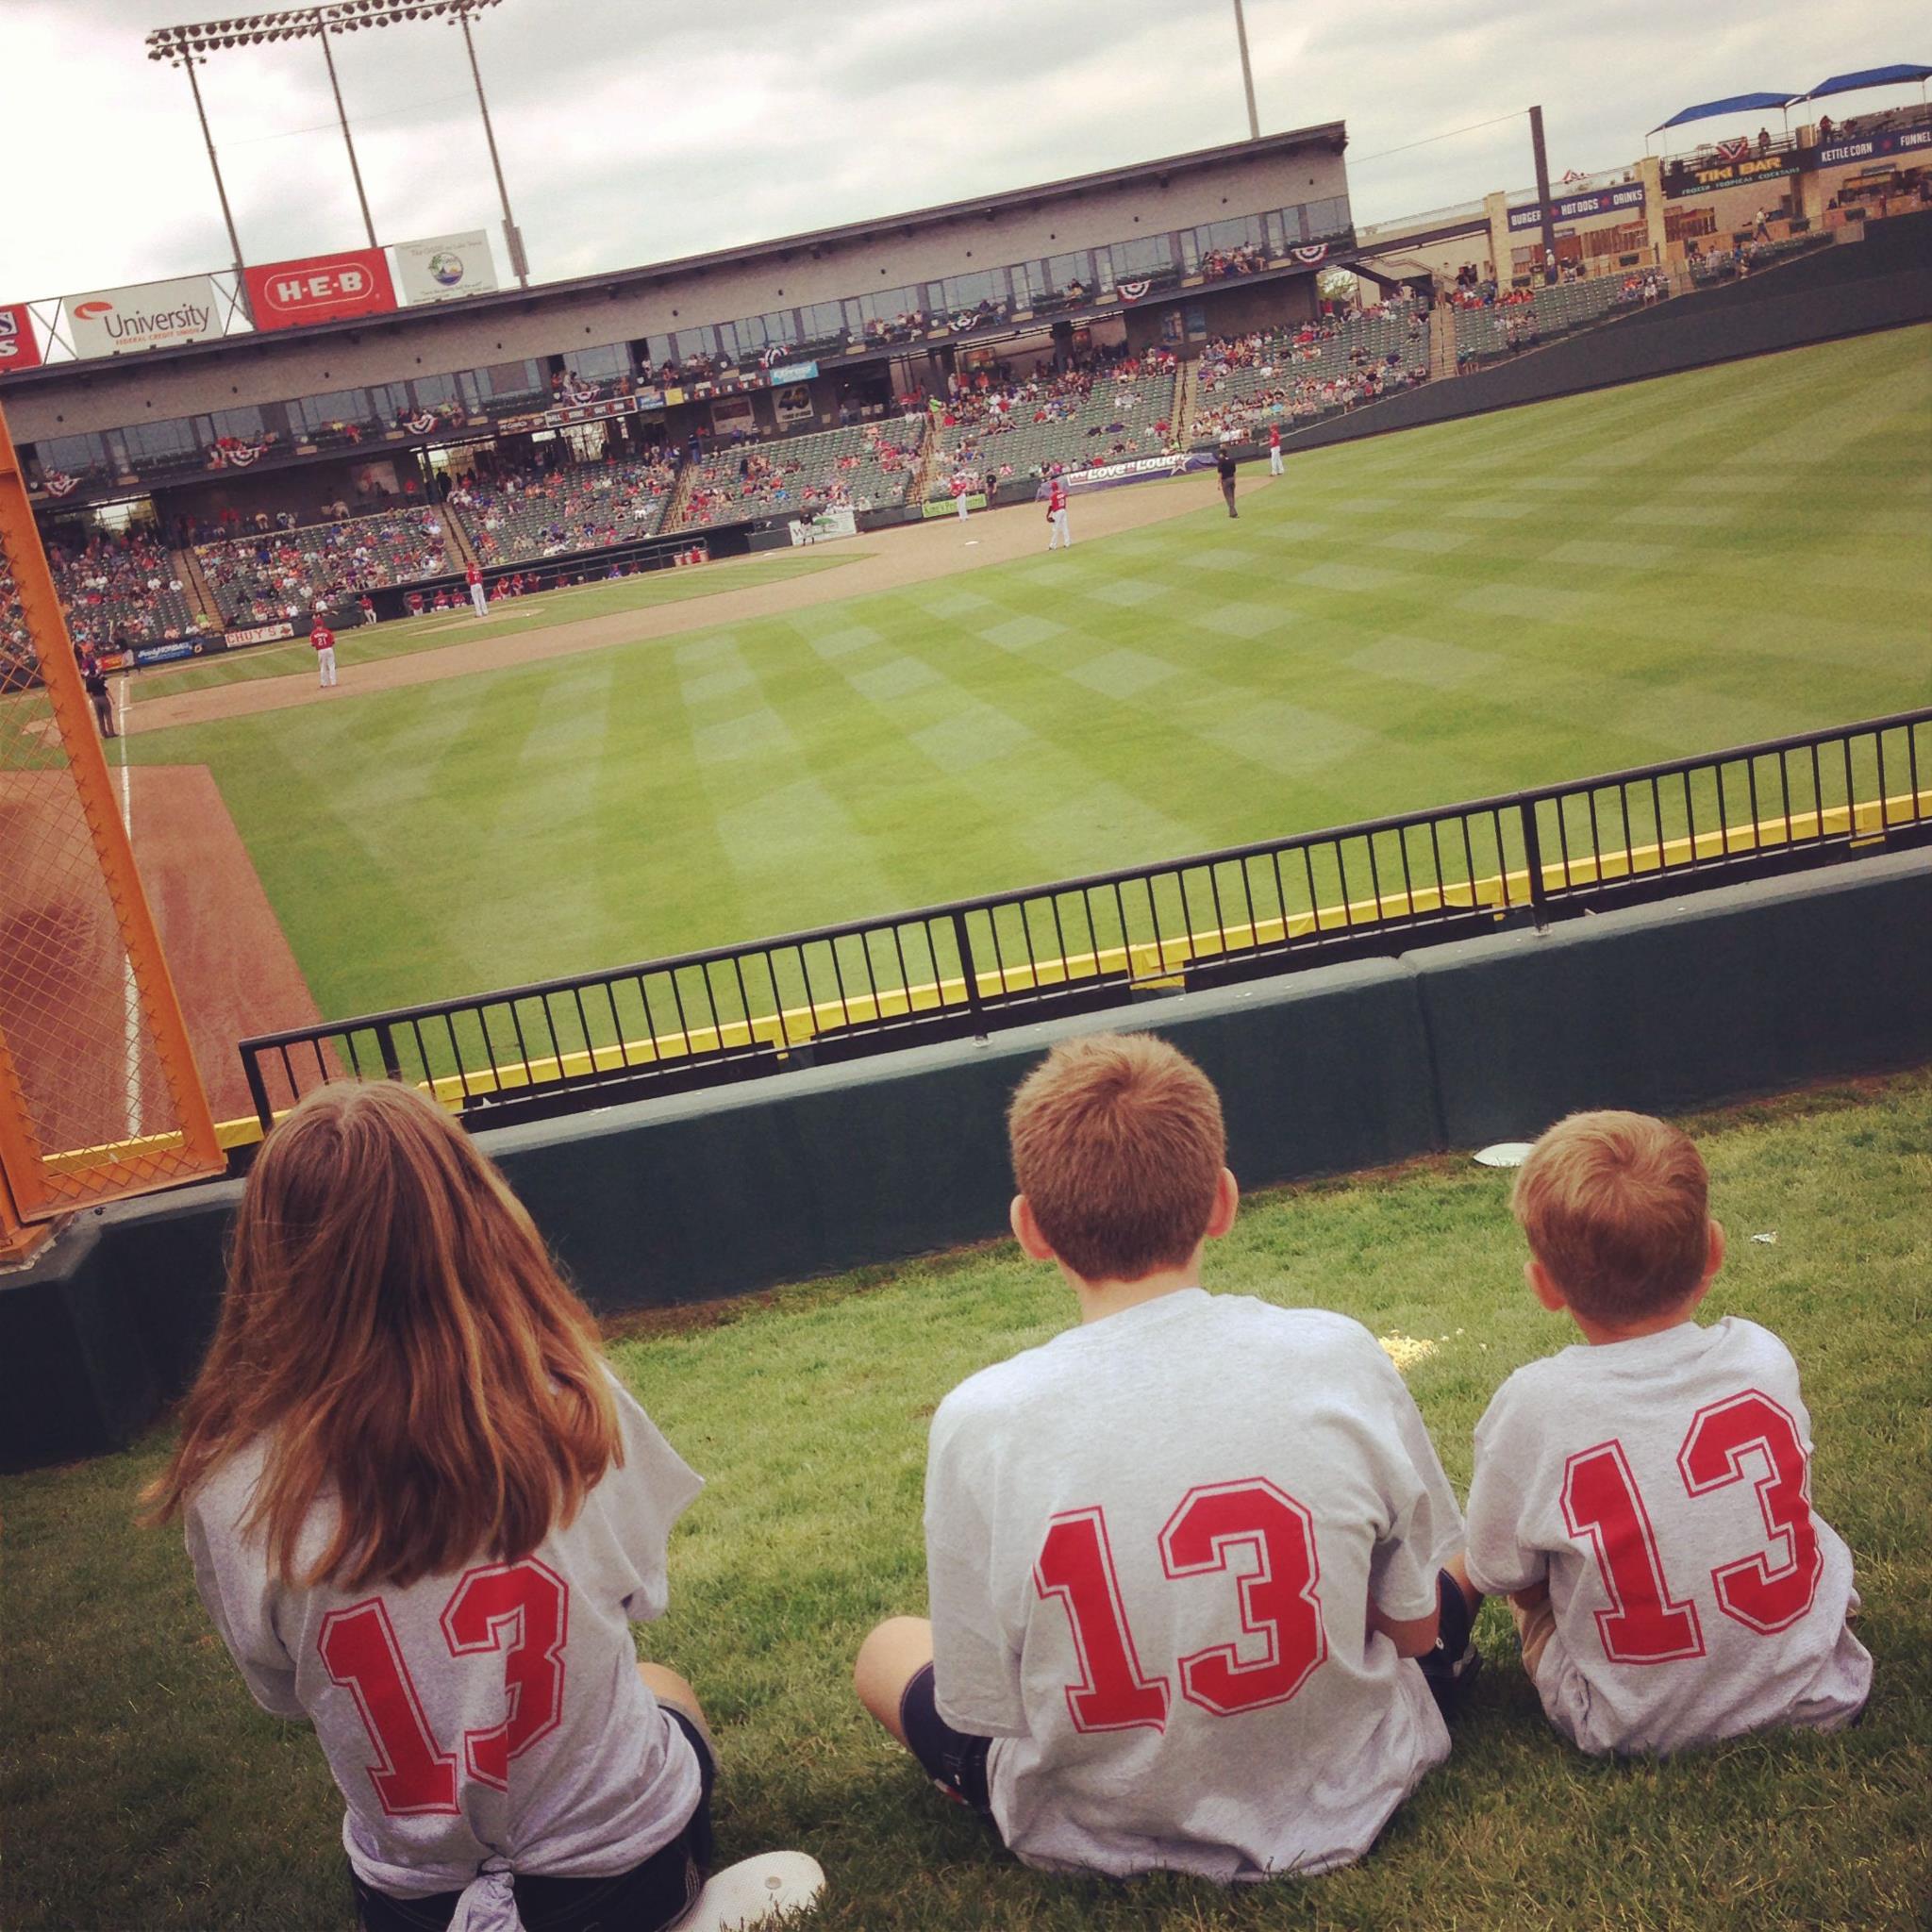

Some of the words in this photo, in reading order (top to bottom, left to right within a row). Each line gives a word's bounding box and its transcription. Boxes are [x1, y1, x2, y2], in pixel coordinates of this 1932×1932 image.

[1900, 131, 1932, 146] FUNNEL
[1821, 146, 1849, 162] KETTLE
[1849, 142, 1873, 157] CORN
[1696, 166, 1733, 184] TIKI
[1739, 157, 1782, 175] BAR
[1561, 203, 1576, 216] HOT
[1577, 198, 1599, 212] DOGS
[1612, 190, 1643, 206] DRINKS
[104, 303, 209, 339] University
[226, 626, 276, 645] CHUY'S
[318, 637, 327, 646] 21
[1559, 1388, 1824, 1666] 13
[1032, 1475, 1328, 1736] 13
[317, 1553, 569, 1817] 13
